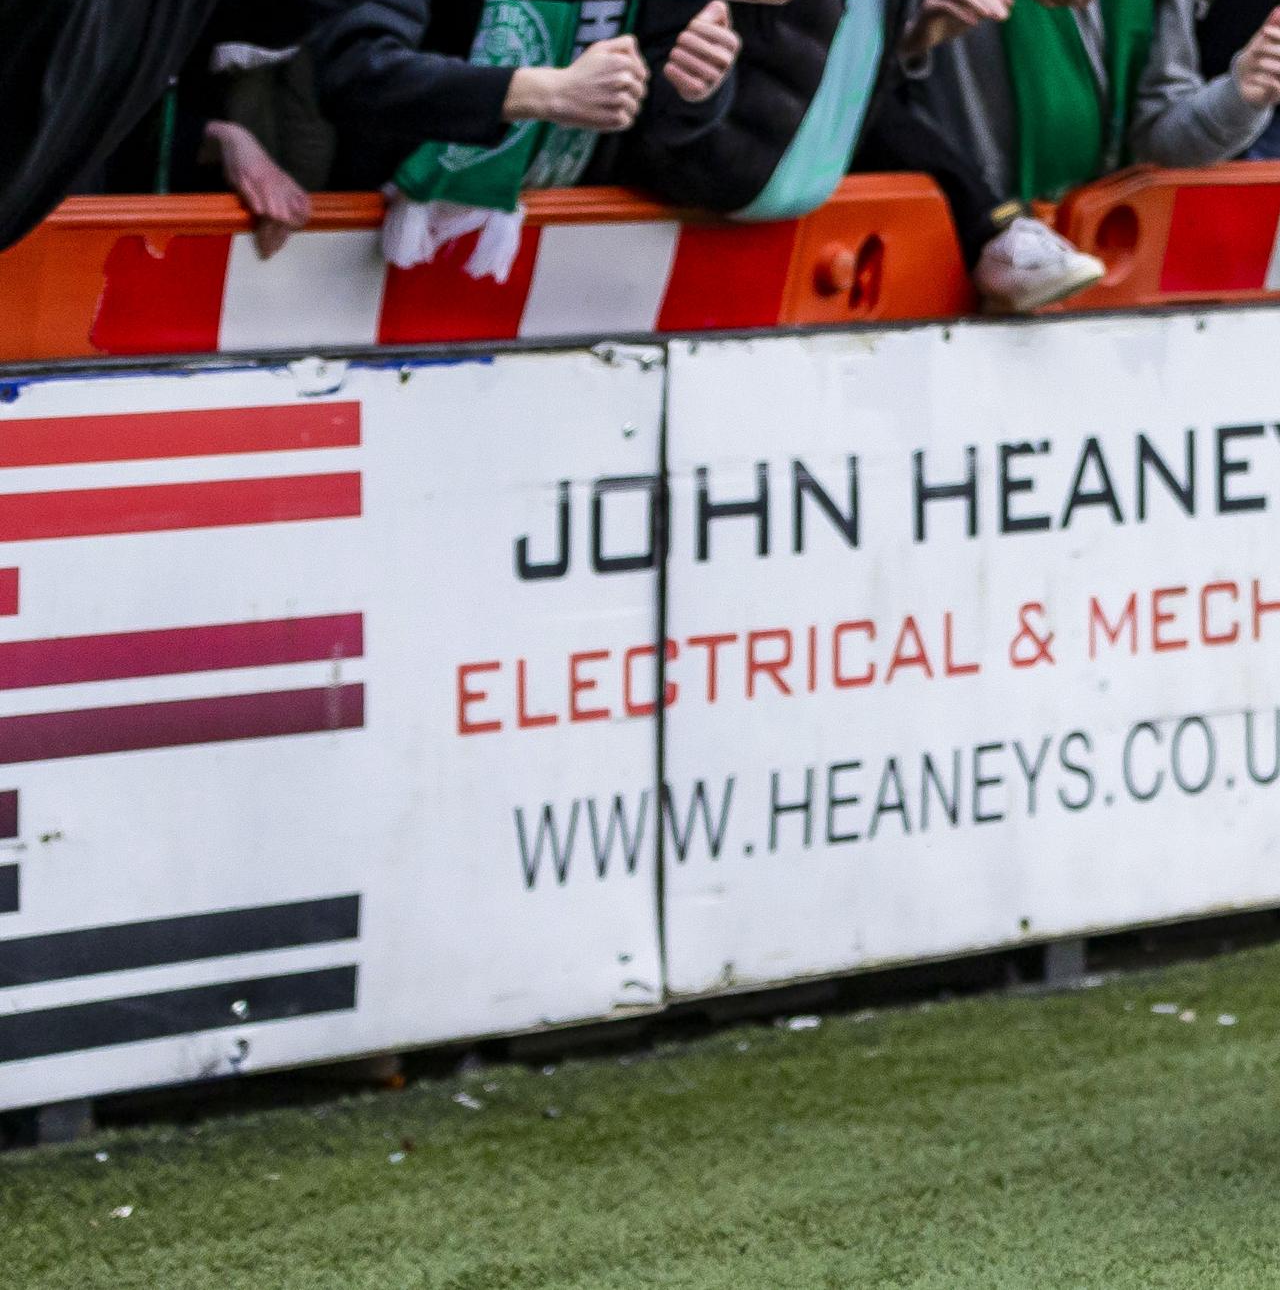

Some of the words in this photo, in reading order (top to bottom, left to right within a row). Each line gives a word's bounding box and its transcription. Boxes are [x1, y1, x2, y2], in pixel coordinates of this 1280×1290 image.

[514, 454, 861, 581] JOHN
[456, 610, 981, 737] ELECTRICAL
[1009, 600, 1056, 670] &
